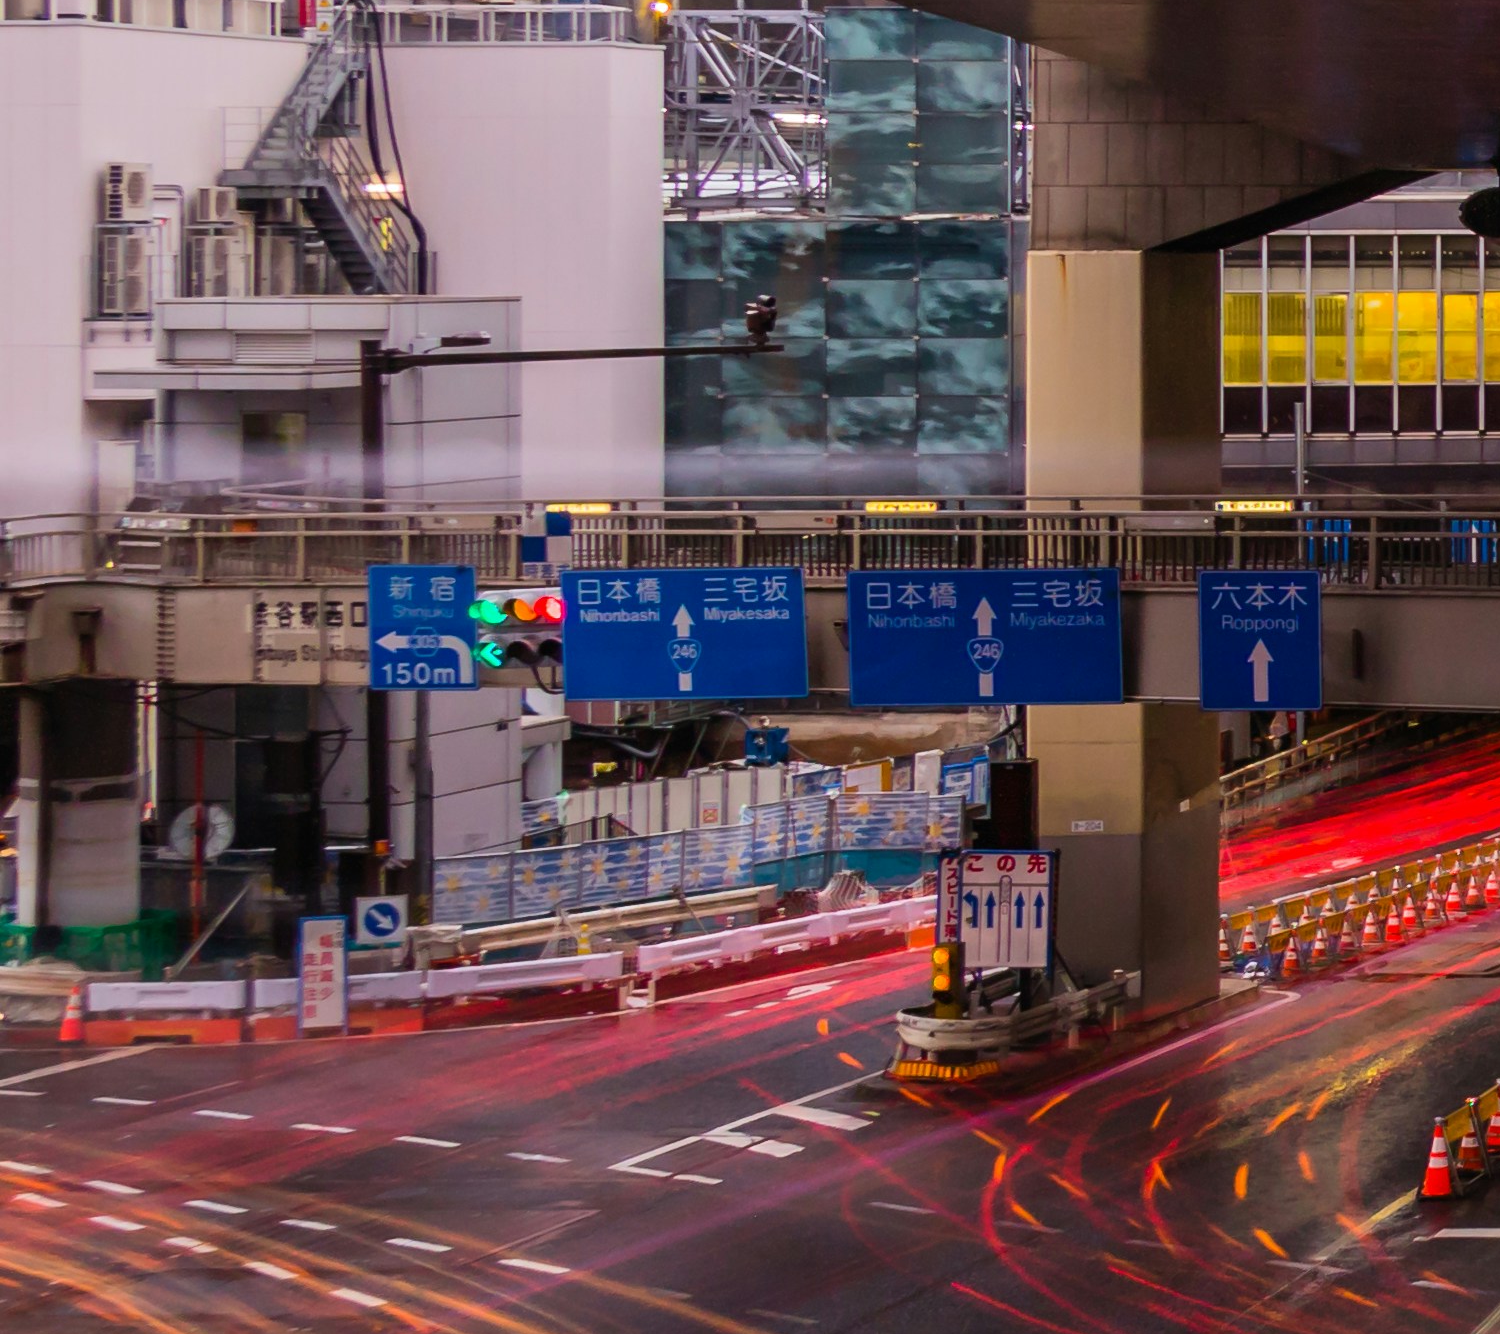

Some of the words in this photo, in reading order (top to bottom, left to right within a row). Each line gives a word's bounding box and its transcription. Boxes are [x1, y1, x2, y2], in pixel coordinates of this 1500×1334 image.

[389, 576, 456, 601] 新宿
[577, 577, 661, 605] 日本橋
[703, 575, 790, 603] 三宅坂
[866, 581, 958, 610] 日本橋
[1011, 579, 1104, 608] 三宅坂
[1211, 581, 1308, 611] 六本木
[393, 605, 454, 621] Shinjuku
[580, 608, 660, 623] Nihonbashi
[867, 613, 955, 629] Nihonbashi
[1010, 612, 1106, 628] Miyakezaka
[1221, 614, 1300, 634] Roppongi
[672, 643, 697, 660] 246
[973, 642, 1001, 660] 246
[382, 662, 456, 684] 150m
[966, 854, 1047, 874] この先
